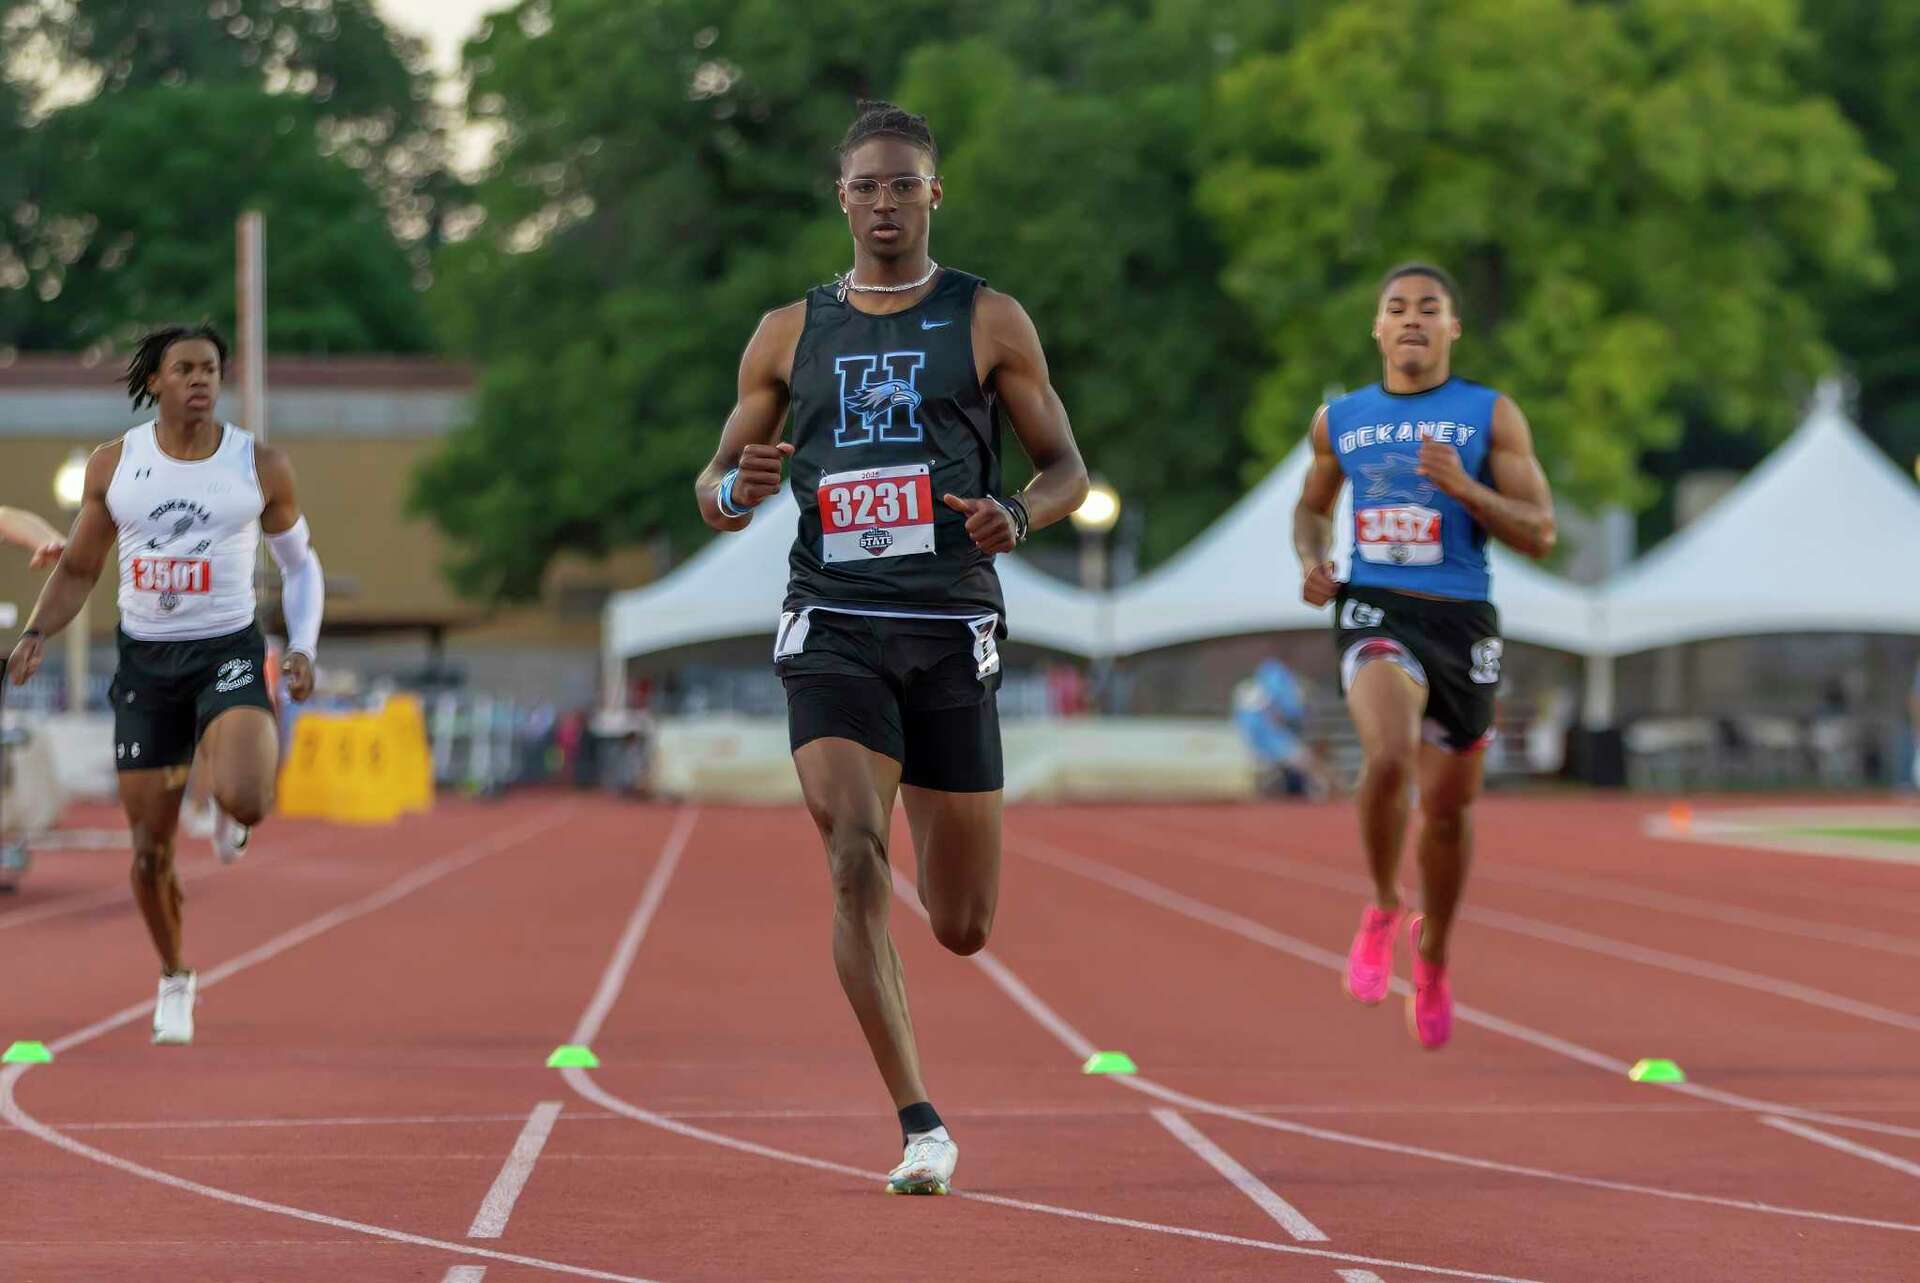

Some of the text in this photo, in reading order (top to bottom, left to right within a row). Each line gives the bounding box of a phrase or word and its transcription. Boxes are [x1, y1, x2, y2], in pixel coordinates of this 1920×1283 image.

[1338, 421, 1478, 455] DEKANEY
[829, 480, 919, 528] 3231
[860, 536, 892, 547] STATE
